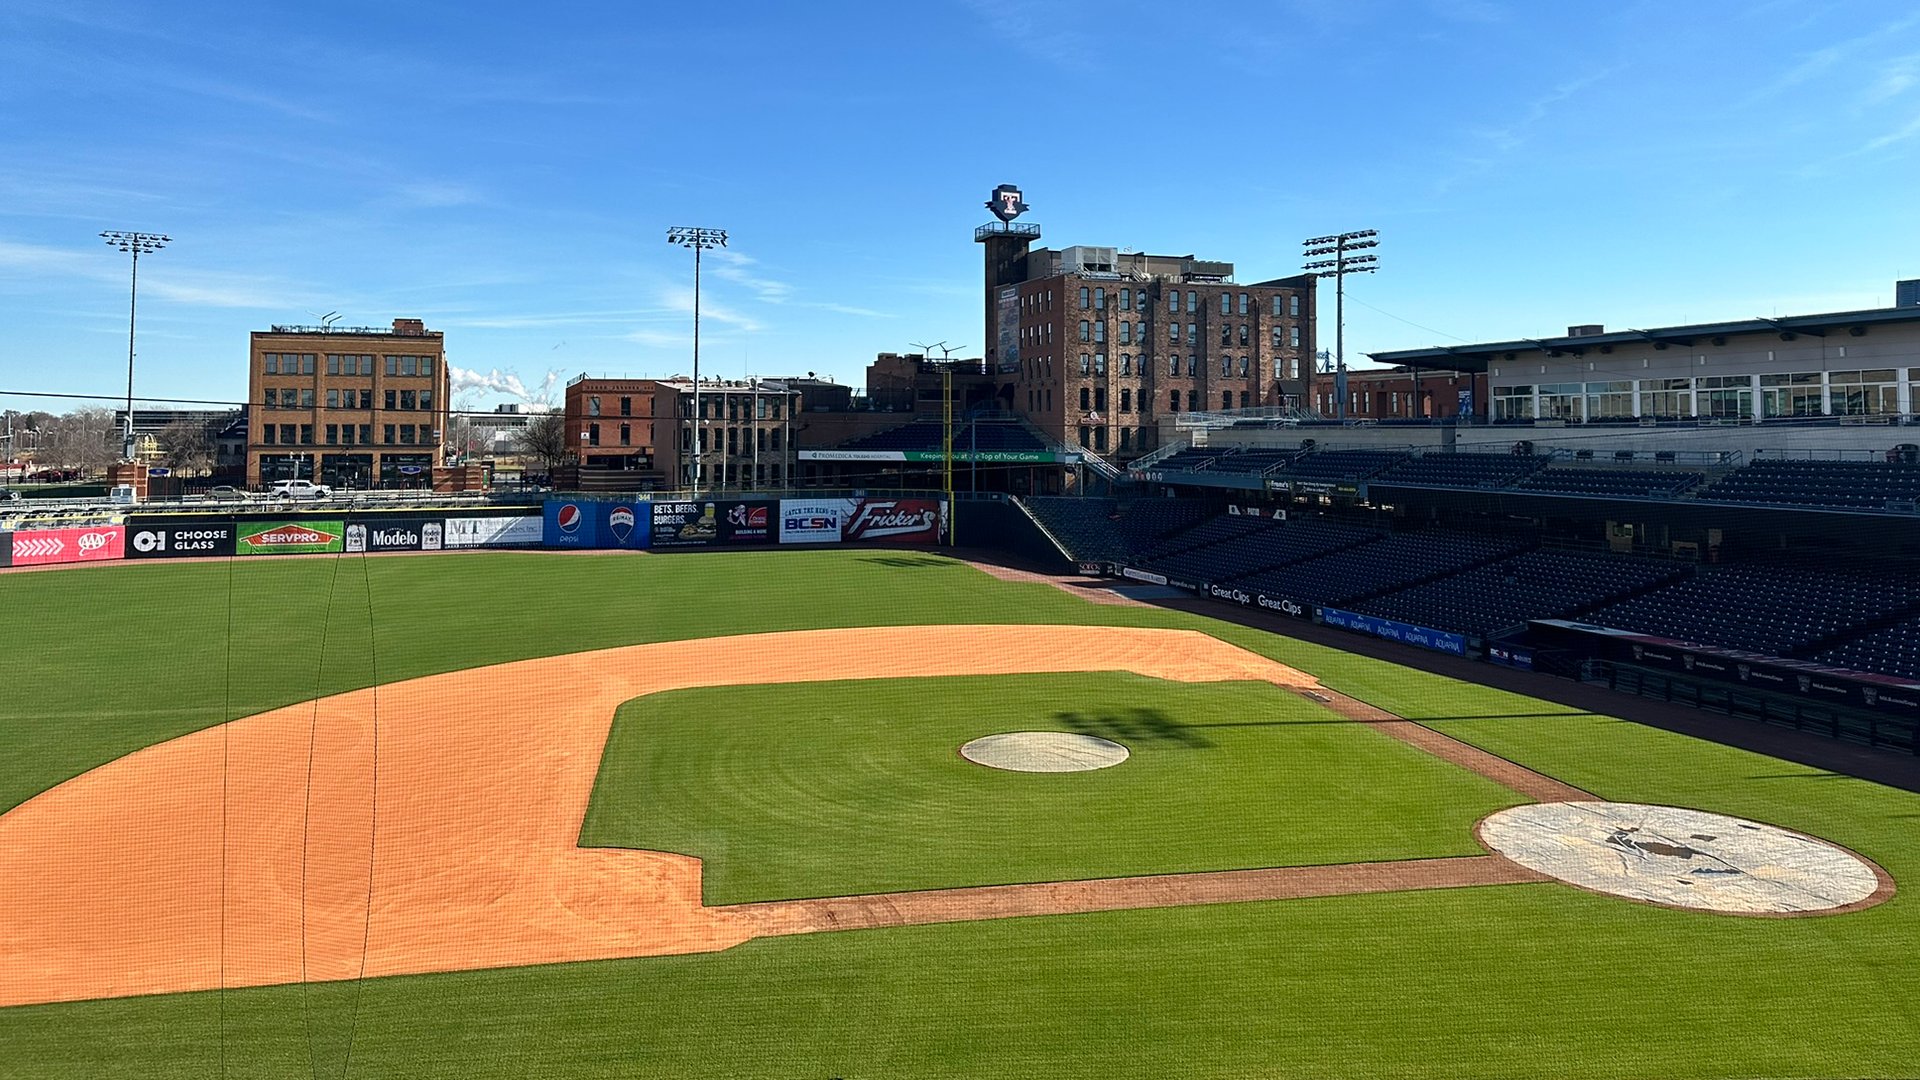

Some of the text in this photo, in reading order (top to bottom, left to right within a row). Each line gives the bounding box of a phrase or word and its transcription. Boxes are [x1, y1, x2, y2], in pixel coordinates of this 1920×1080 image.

[981, 453, 992, 461] Top
[654, 504, 699, 514] BETS. BEERS.
[654, 515, 687, 525] BURGERS.
[785, 517, 837, 530] BCSN
[174, 530, 228, 540] CHOOSE
[372, 530, 418, 546] Modelo
[560, 535, 579, 543] pepsi
[80, 533, 105, 549] AAA
[174, 541, 215, 550] GLASS
[1211, 584, 1232, 600] Great
[1232, 589, 1250, 605] Clips
[1258, 594, 1302, 616] Great Clips
